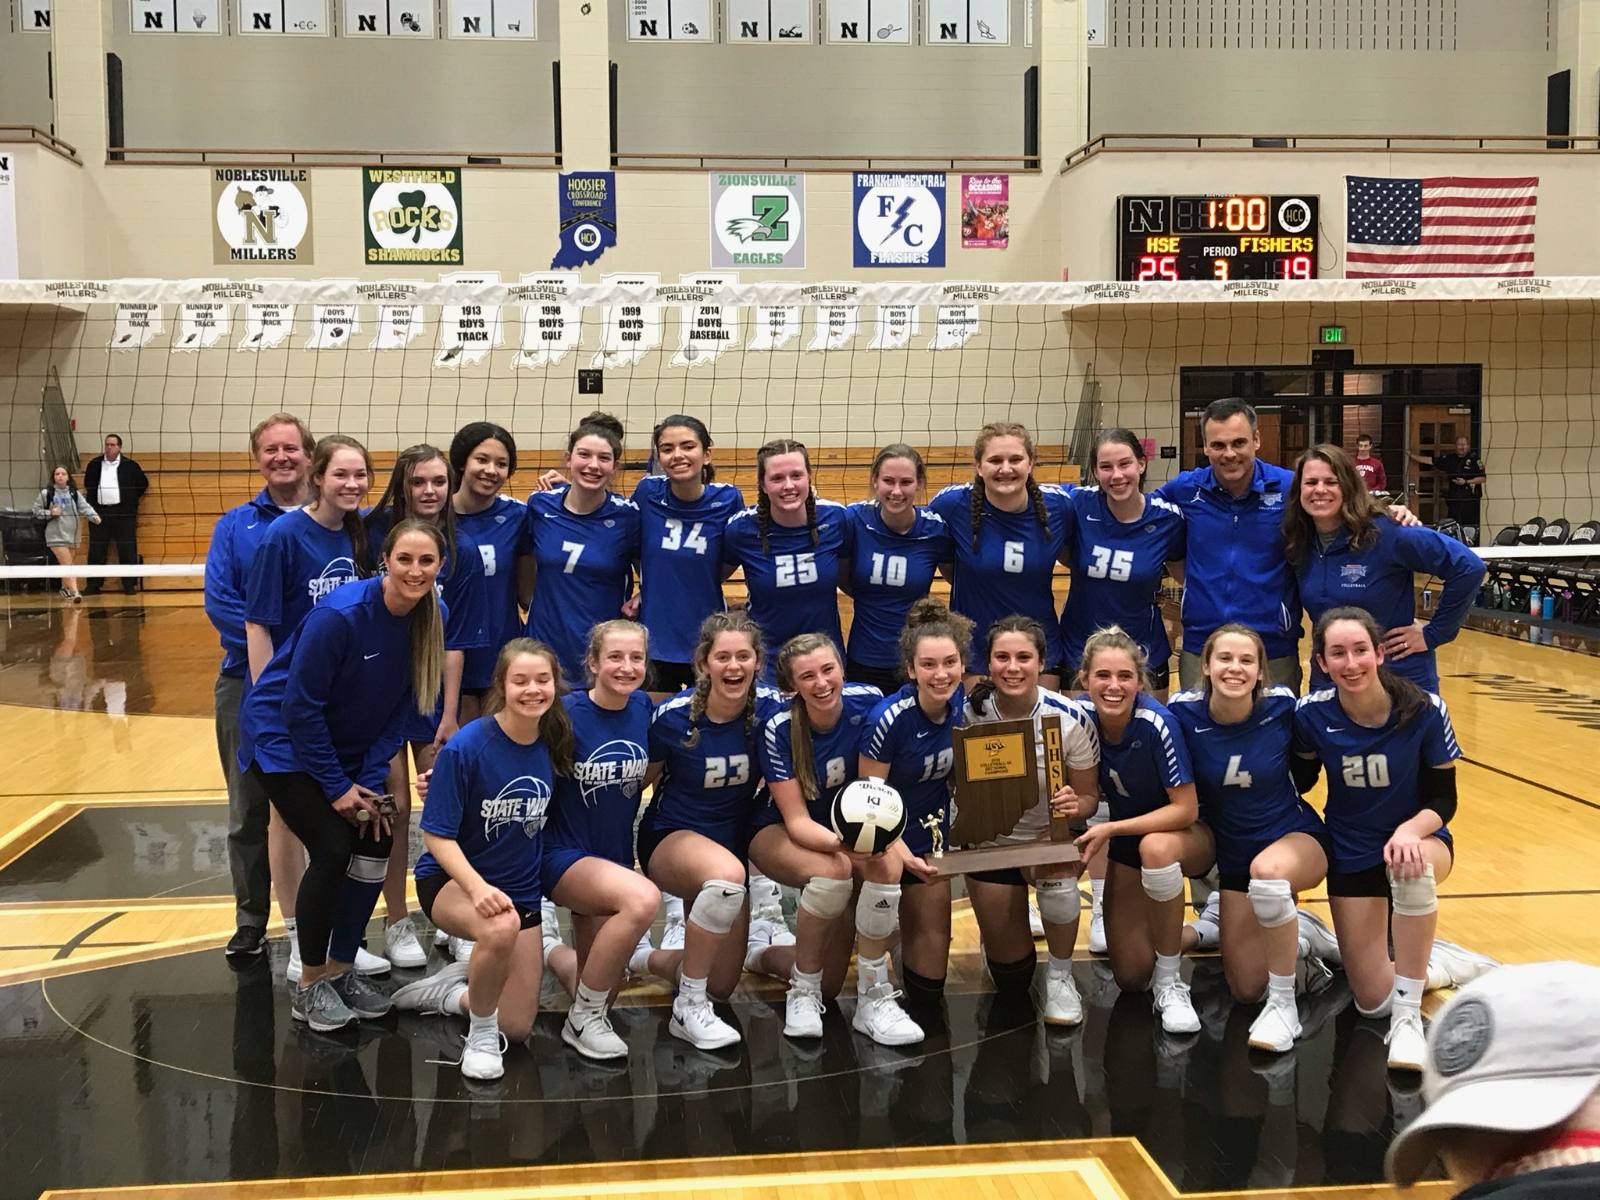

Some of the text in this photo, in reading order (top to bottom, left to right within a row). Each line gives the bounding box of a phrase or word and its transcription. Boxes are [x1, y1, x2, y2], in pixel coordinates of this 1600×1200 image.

[35, 11, 50, 27] N
[145, 12, 162, 28] N
[253, 13, 271, 29] N
[358, 15, 376, 31] N
[463, 16, 480, 32] N
[640, 20, 657, 36] N
[741, 22, 758, 37] N
[841, 22, 858, 38] N
[940, 23, 957, 39] N
[215, 169, 307, 182] NOBLESVILLE
[369, 169, 455, 184] WESTFIELD
[719, 175, 797, 187] ZIONSVILLE
[857, 174, 946, 188] FRANKLIN CENTRAL
[968, 176, 983, 184] Rise
[992, 176, 1002, 184] the
[567, 178, 606, 191] HOOSIER
[566, 190, 608, 200] CROSSROADS
[877, 196, 895, 217] F
[372, 206, 454, 232] ROCKS
[752, 195, 789, 241] Z
[1129, 200, 1164, 232] N
[1208, 198, 1266, 231] 1:00
[1285, 209, 1304, 222] HCC
[243, 209, 278, 245] N
[580, 233, 594, 244] HCC
[903, 224, 923, 247] C
[1147, 237, 1180, 253] HSE
[1203, 246, 1238, 257] PERIOD
[1240, 237, 1314, 253] FISHERS
[230, 248, 297, 260] MILLERS
[368, 248, 460, 262] SHAMROCKS
[733, 252, 783, 264] EAGLES
[870, 252, 929, 264] FLASHES
[45, 281, 108, 293] NOBLESVILLE
[201, 282, 264, 293] NOBLESVILLE
[356, 284, 418, 294] NOBLESVILLE
[507, 285, 567, 295] NOBLESVILLE
[801, 285, 858, 295] NOBLESVILLE
[943, 284, 1000, 295] NOBLESVILLE
[1084, 283, 1140, 294] NOBLESVILLE
[1223, 281, 1280, 291] NOBLESVILLE
[1361, 280, 1416, 290] NOBLESVILLE
[1497, 279, 1552, 289] NOBLESVILLE
[1507, 286, 1541, 294] MILLERS
[57, 290, 98, 298] MILLERS
[213, 291, 253, 299] MILLERS
[368, 292, 406, 300] MILLERS
[519, 293, 557, 301] MILLERS
[656, 286, 714, 296] NOBLESVILLE
[953, 292, 989, 300] MILLERS
[1094, 291, 1130, 299] MILLERS
[1233, 289, 1269, 297] MILLERS
[461, 306, 482, 316] 1913
[621, 306, 641, 316] 1999
[700, 306, 720, 315] 2014
[459, 319, 485, 328] BOYS
[539, 318, 564, 328] BOYS
[619, 319, 644, 329] BOYS
[697, 318, 722, 327] BOYS
[457, 331, 489, 341] TRACK
[541, 331, 562, 340] GOLF
[621, 332, 642, 341] GOLF
[690, 330, 730, 340] BASEBALL
[1325, 328, 1342, 342] EXIT
[587, 377, 594, 390] F
[661, 518, 707, 554] 34
[562, 541, 585, 574] 7
[1003, 541, 1025, 573] 6
[1088, 545, 1135, 582] 35
[775, 553, 819, 588] 25
[870, 552, 908, 587] 10
[574, 761, 616, 780] STATE
[703, 754, 750, 788] 23
[918, 747, 954, 783] 19
[1223, 755, 1252, 788] 4
[1342, 754, 1390, 788] 20
[826, 756, 846, 788] 8
[1109, 768, 1130, 798] 1
[480, 798, 523, 818] STATE
